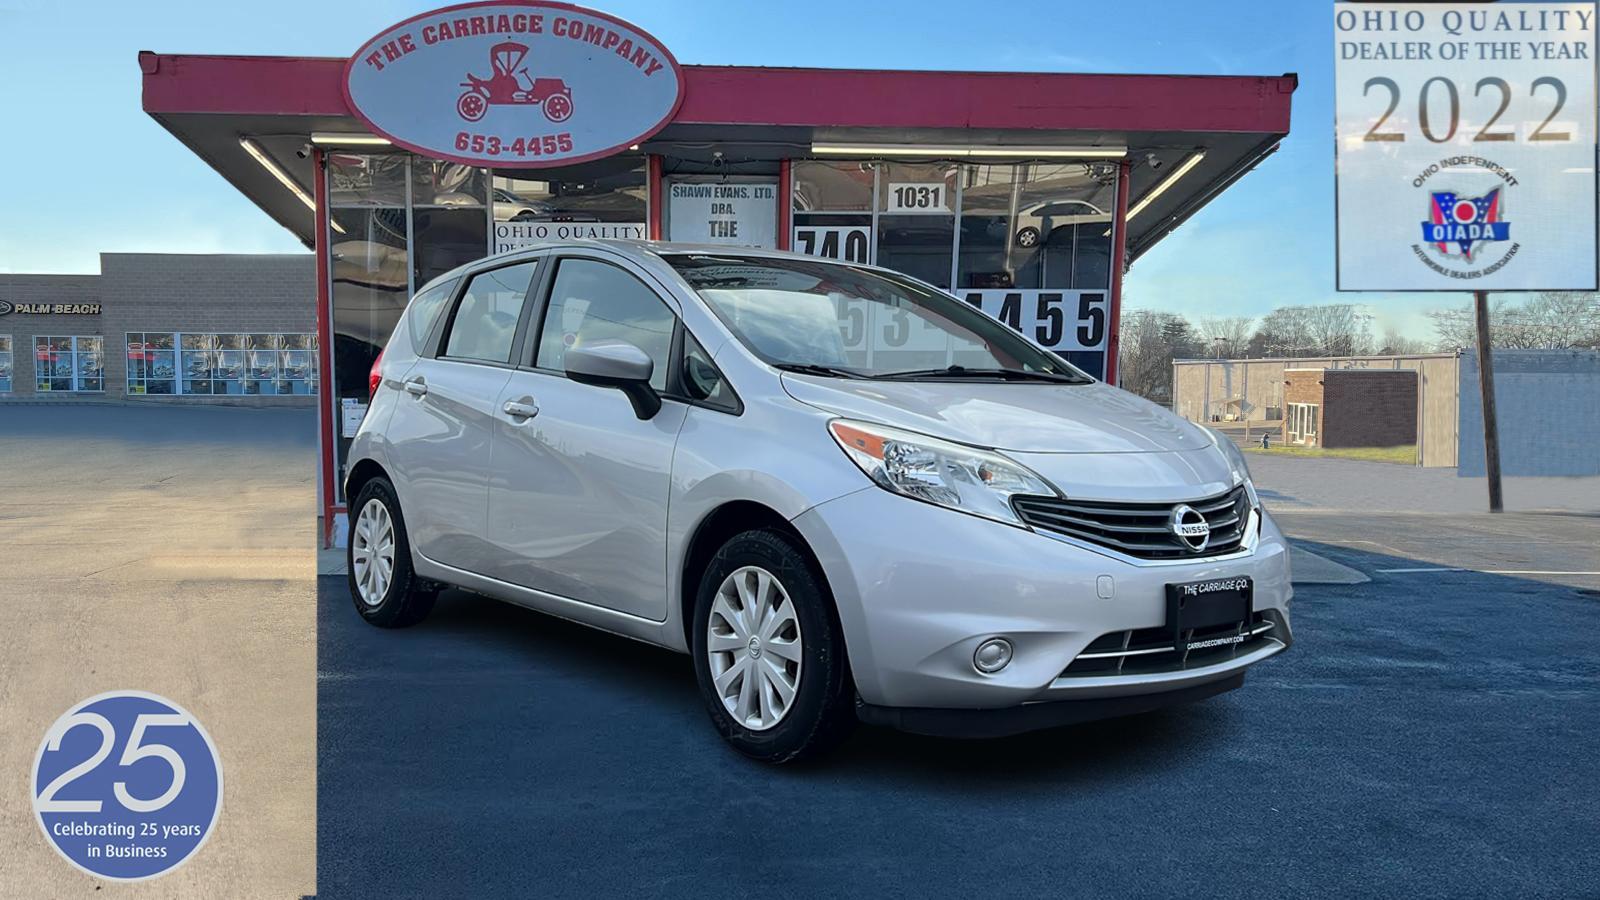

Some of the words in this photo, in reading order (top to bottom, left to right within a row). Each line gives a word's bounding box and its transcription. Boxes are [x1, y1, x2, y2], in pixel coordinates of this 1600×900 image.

[1336, 10, 1425, 31] OHIO
[1442, 10, 1593, 36] QUALITY
[365, 33, 417, 72] THE
[422, 15, 544, 46] CARRIAGE
[552, 17, 664, 77] COMPANY
[1340, 42, 1433, 60] DEALER
[1438, 42, 1470, 60] OF
[1474, 42, 1522, 60] THE
[1528, 41, 1589, 60] YEAR
[1362, 76, 1571, 143] 2022
[454, 132, 573, 156] 653-4455
[1412, 164, 1439, 188] OHIO
[1440, 155, 1519, 188] INDEPENDENT
[672, 186, 712, 198] SHAWN
[754, 187, 775, 199] LTD.
[895, 187, 940, 208] 1031
[711, 203, 736, 215] DBA.
[496, 226, 548, 239] OHIO
[557, 226, 644, 240] QUALITY
[708, 220, 738, 238] THE
[1432, 224, 1495, 240] OIADA
[1450, 270, 1482, 280] DEALERS
[14, 304, 50, 314] PALM
[54, 304, 100, 314] BEACH
[1181, 524, 1209, 535] NISSAN
[1183, 585, 1198, 595] THE
[1198, 581, 1235, 593] CARRIAGE
[1186, 635, 1244, 650] CARRIAGECOMPANY.COM
